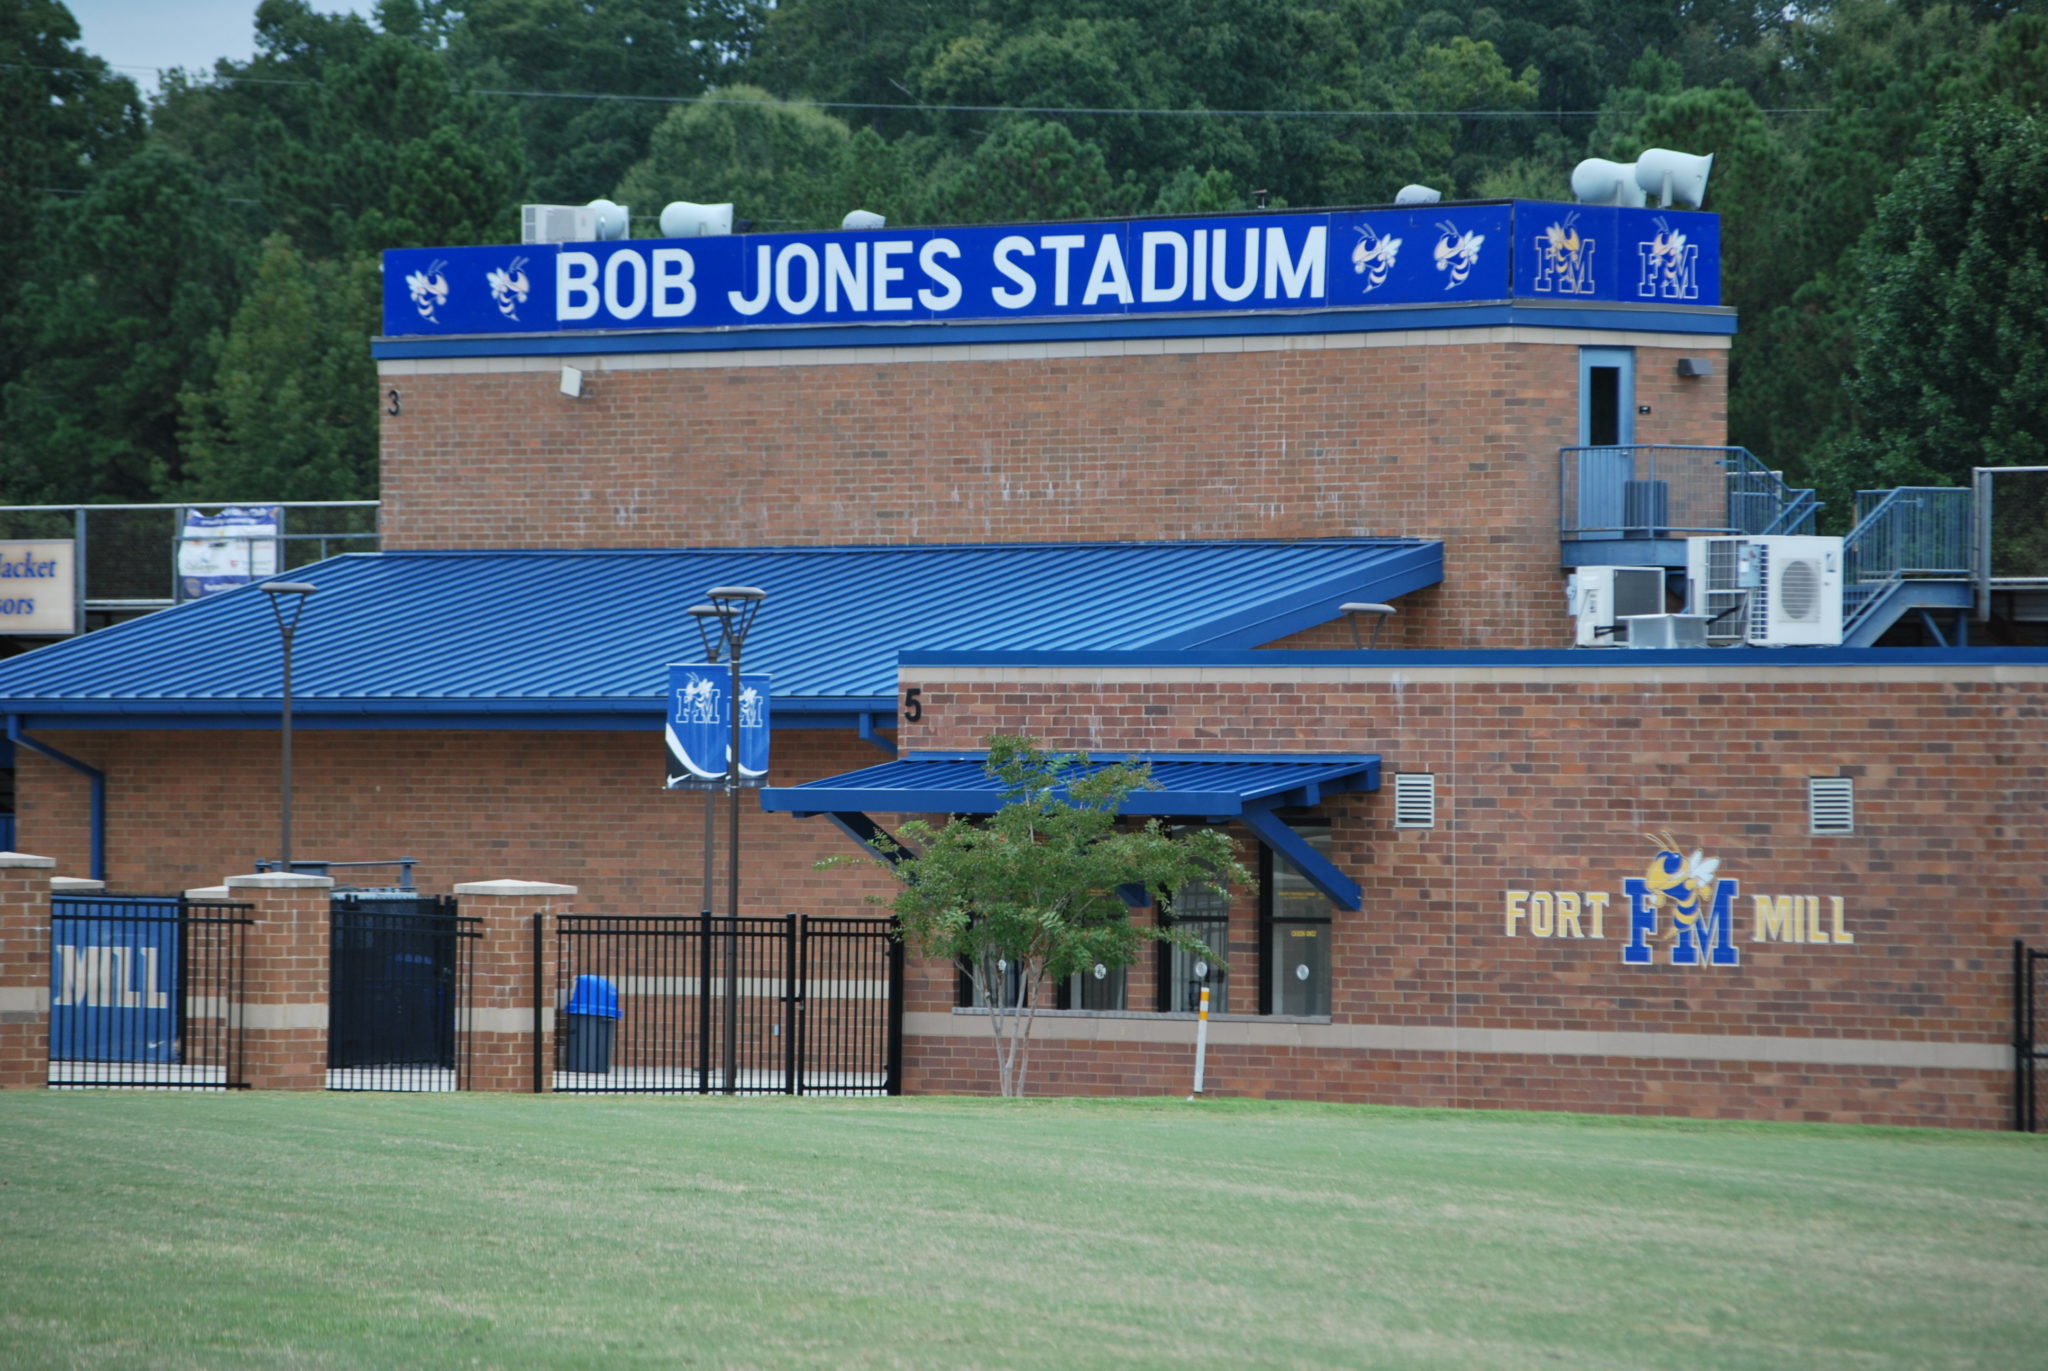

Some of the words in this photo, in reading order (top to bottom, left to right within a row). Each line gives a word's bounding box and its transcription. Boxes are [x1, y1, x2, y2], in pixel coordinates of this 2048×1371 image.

[556, 248, 696, 320] BOB
[728, 239, 963, 317] JONES
[992, 225, 1327, 310] STADIUM
[388, 390, 399, 416] 3
[0, 598, 36, 616] ors
[904, 688, 921, 722] 5
[1505, 890, 1610, 939] FORT
[1751, 894, 1855, 944] MILL
[53, 944, 168, 1009] MILL
